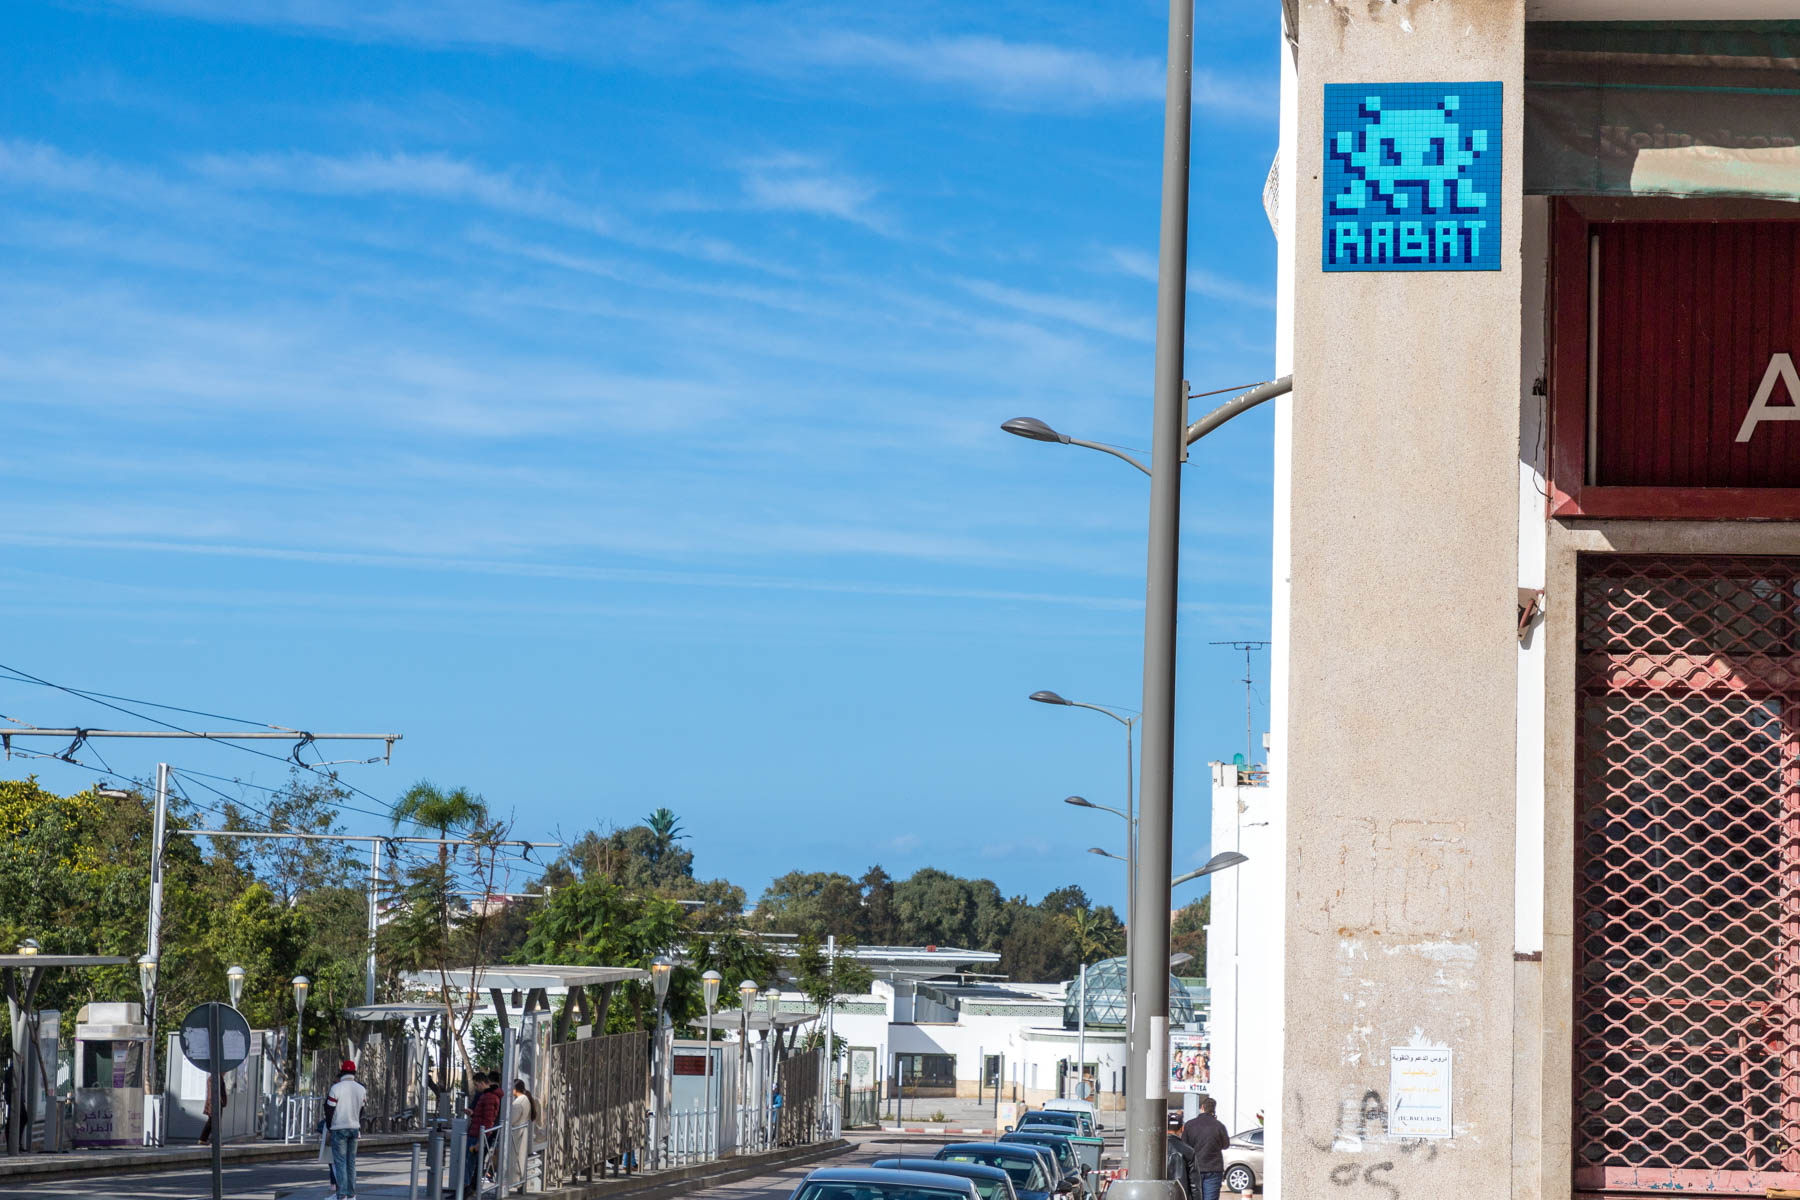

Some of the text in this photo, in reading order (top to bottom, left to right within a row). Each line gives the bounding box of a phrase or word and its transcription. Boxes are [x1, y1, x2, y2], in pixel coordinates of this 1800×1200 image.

[1335, 220, 1487, 258] RABAT
[1190, 1083, 1207, 1091] KITEA
[82, 1110, 113, 1122] تذاكر
[76, 1122, 113, 1135] الطرام
